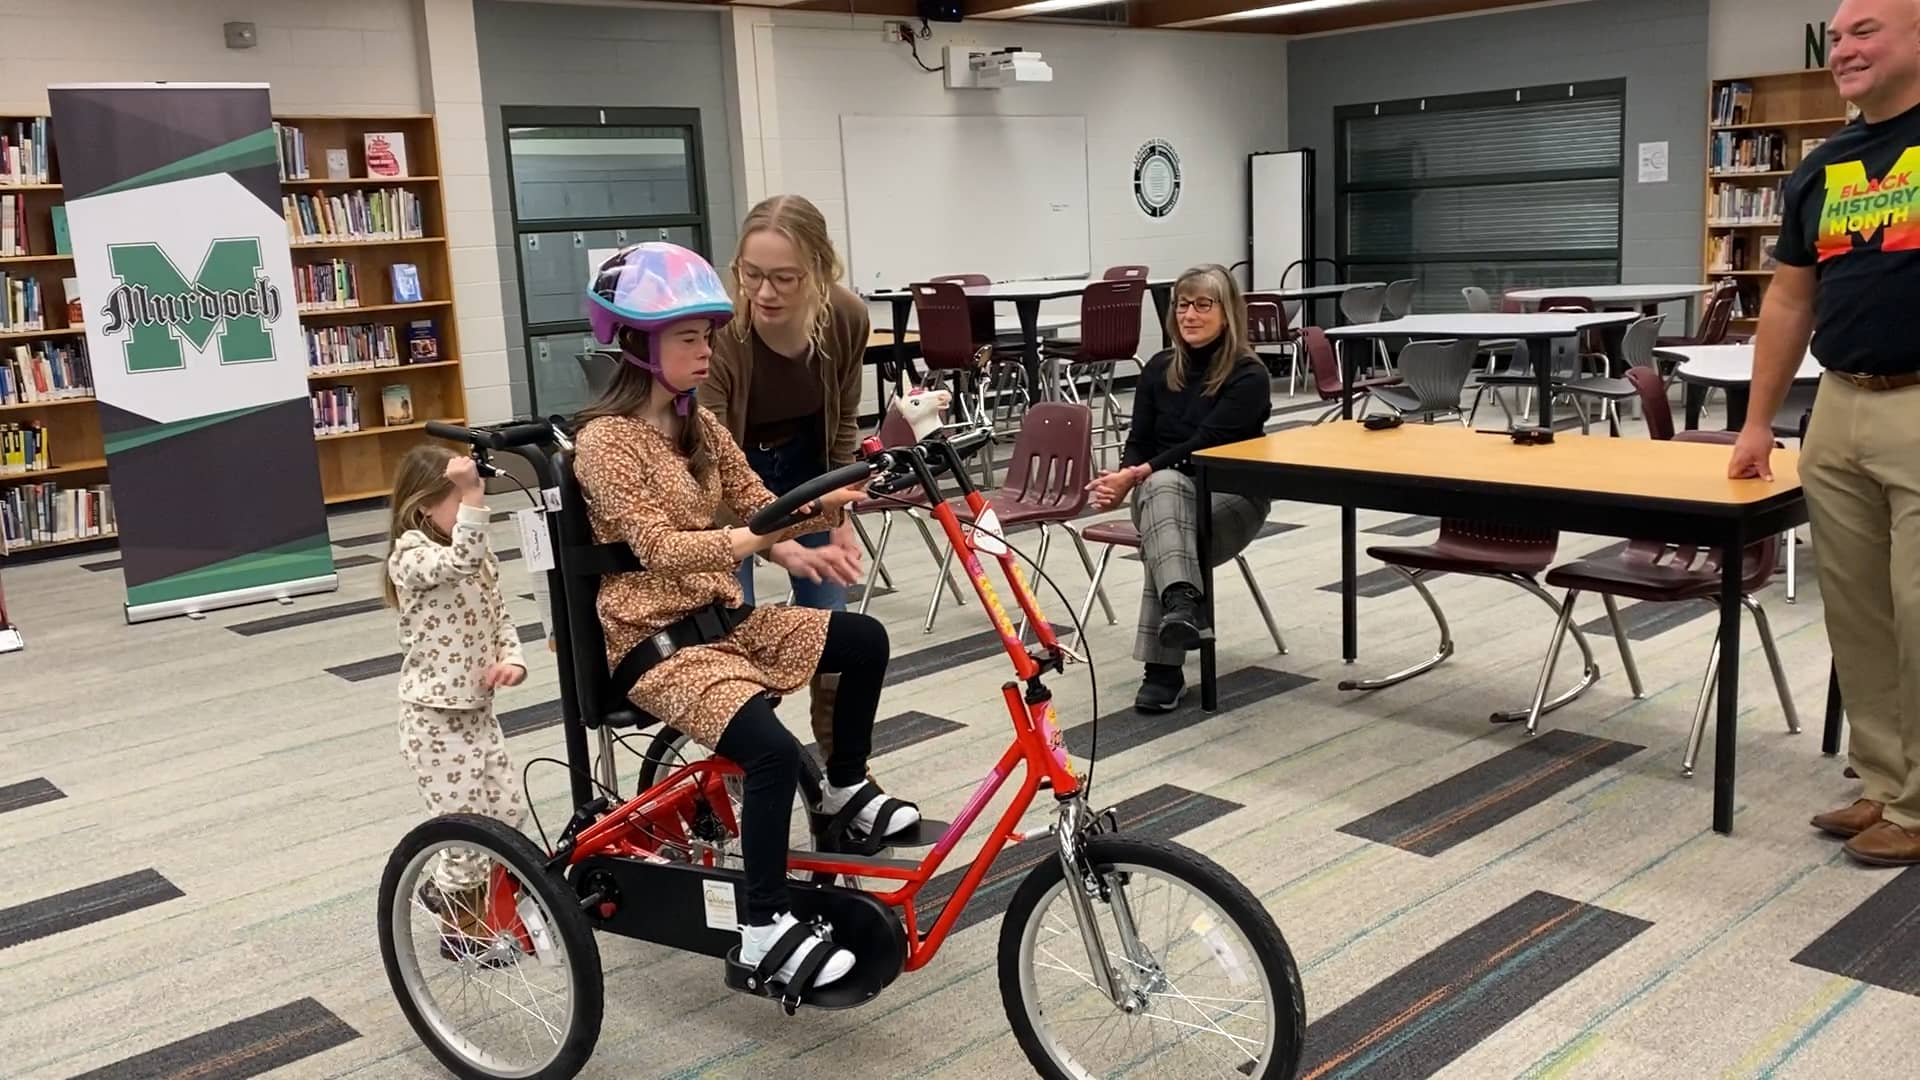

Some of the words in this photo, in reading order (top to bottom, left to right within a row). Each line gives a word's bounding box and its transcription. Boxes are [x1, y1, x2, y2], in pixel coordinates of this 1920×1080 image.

[1827, 186, 1920, 217] HISTORY
[1829, 206, 1909, 236] MONTH
[101, 276, 281, 337] Murdoch
